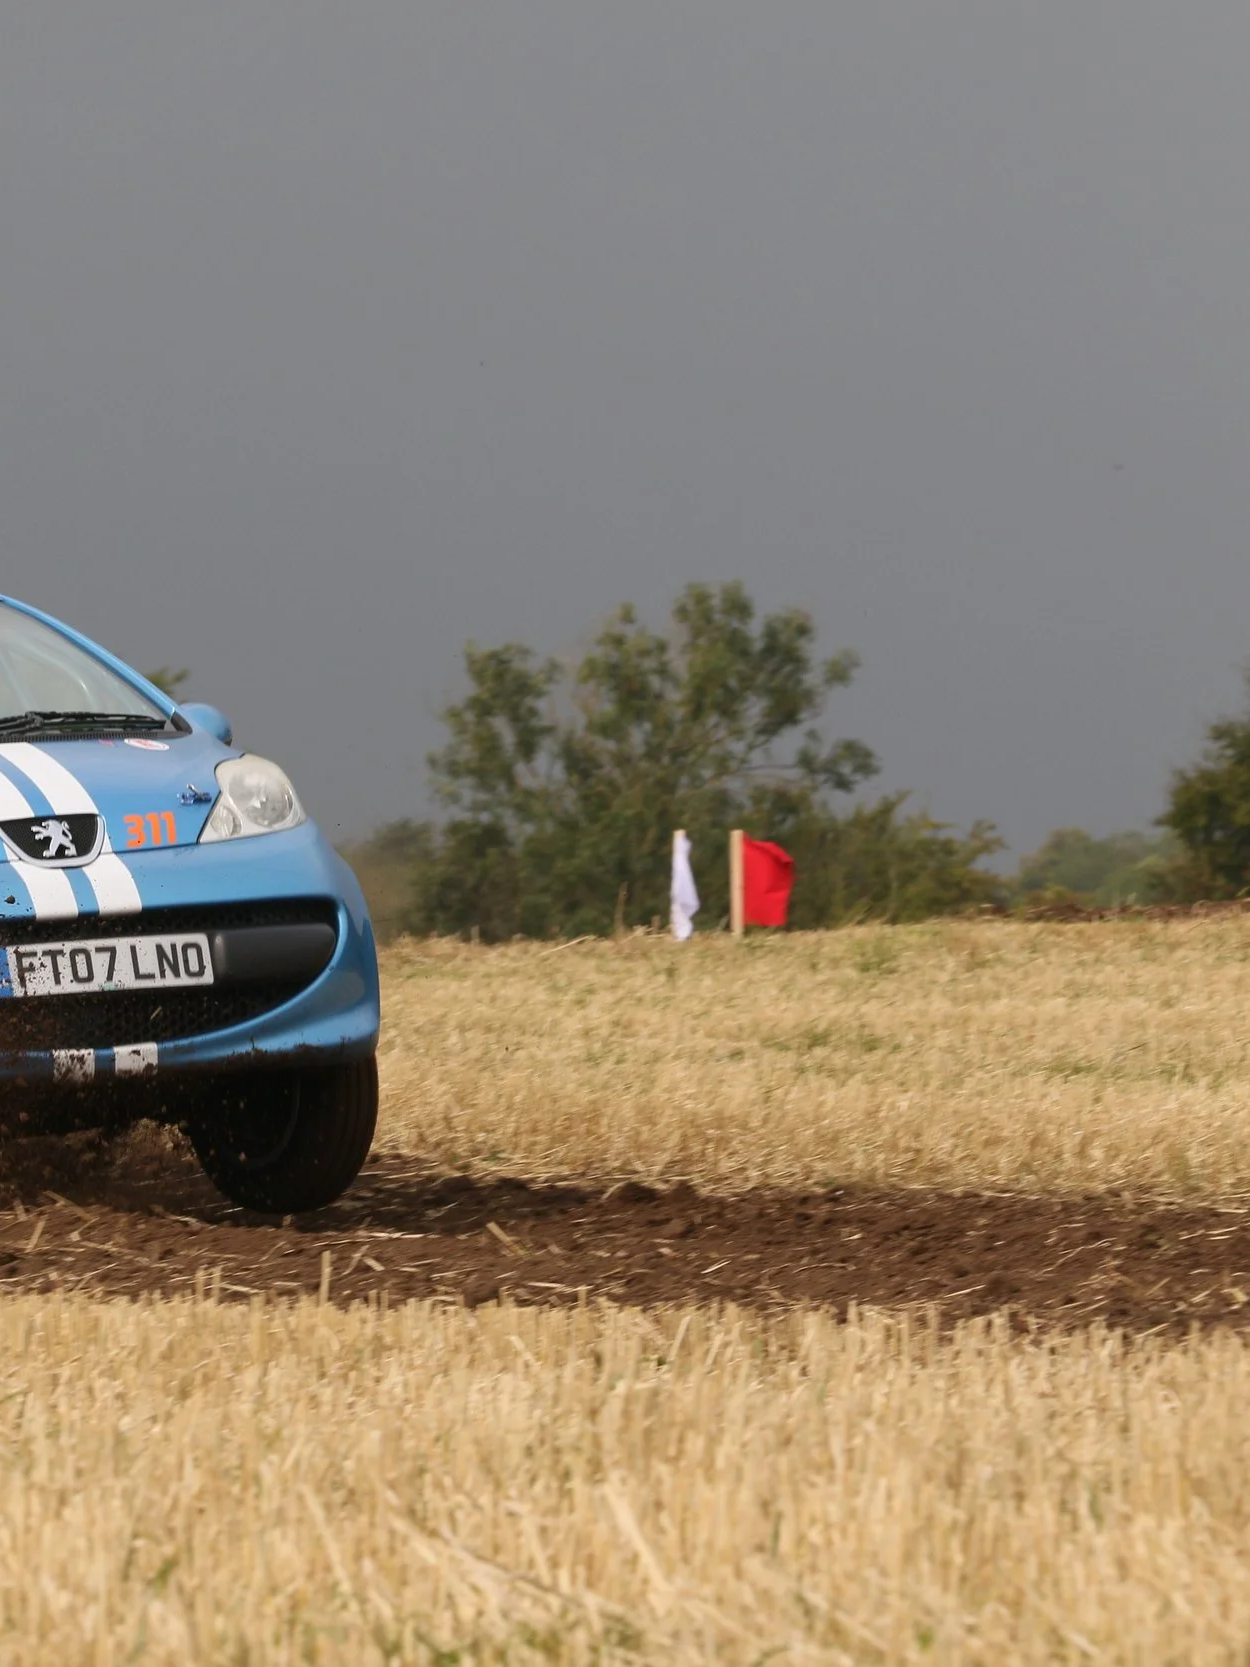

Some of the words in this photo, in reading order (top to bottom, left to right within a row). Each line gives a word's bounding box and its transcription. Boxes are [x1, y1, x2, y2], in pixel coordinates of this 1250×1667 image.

[123, 811, 177, 849] 311
[15, 946, 117, 989] FT07
[129, 942, 207, 981] LNO
